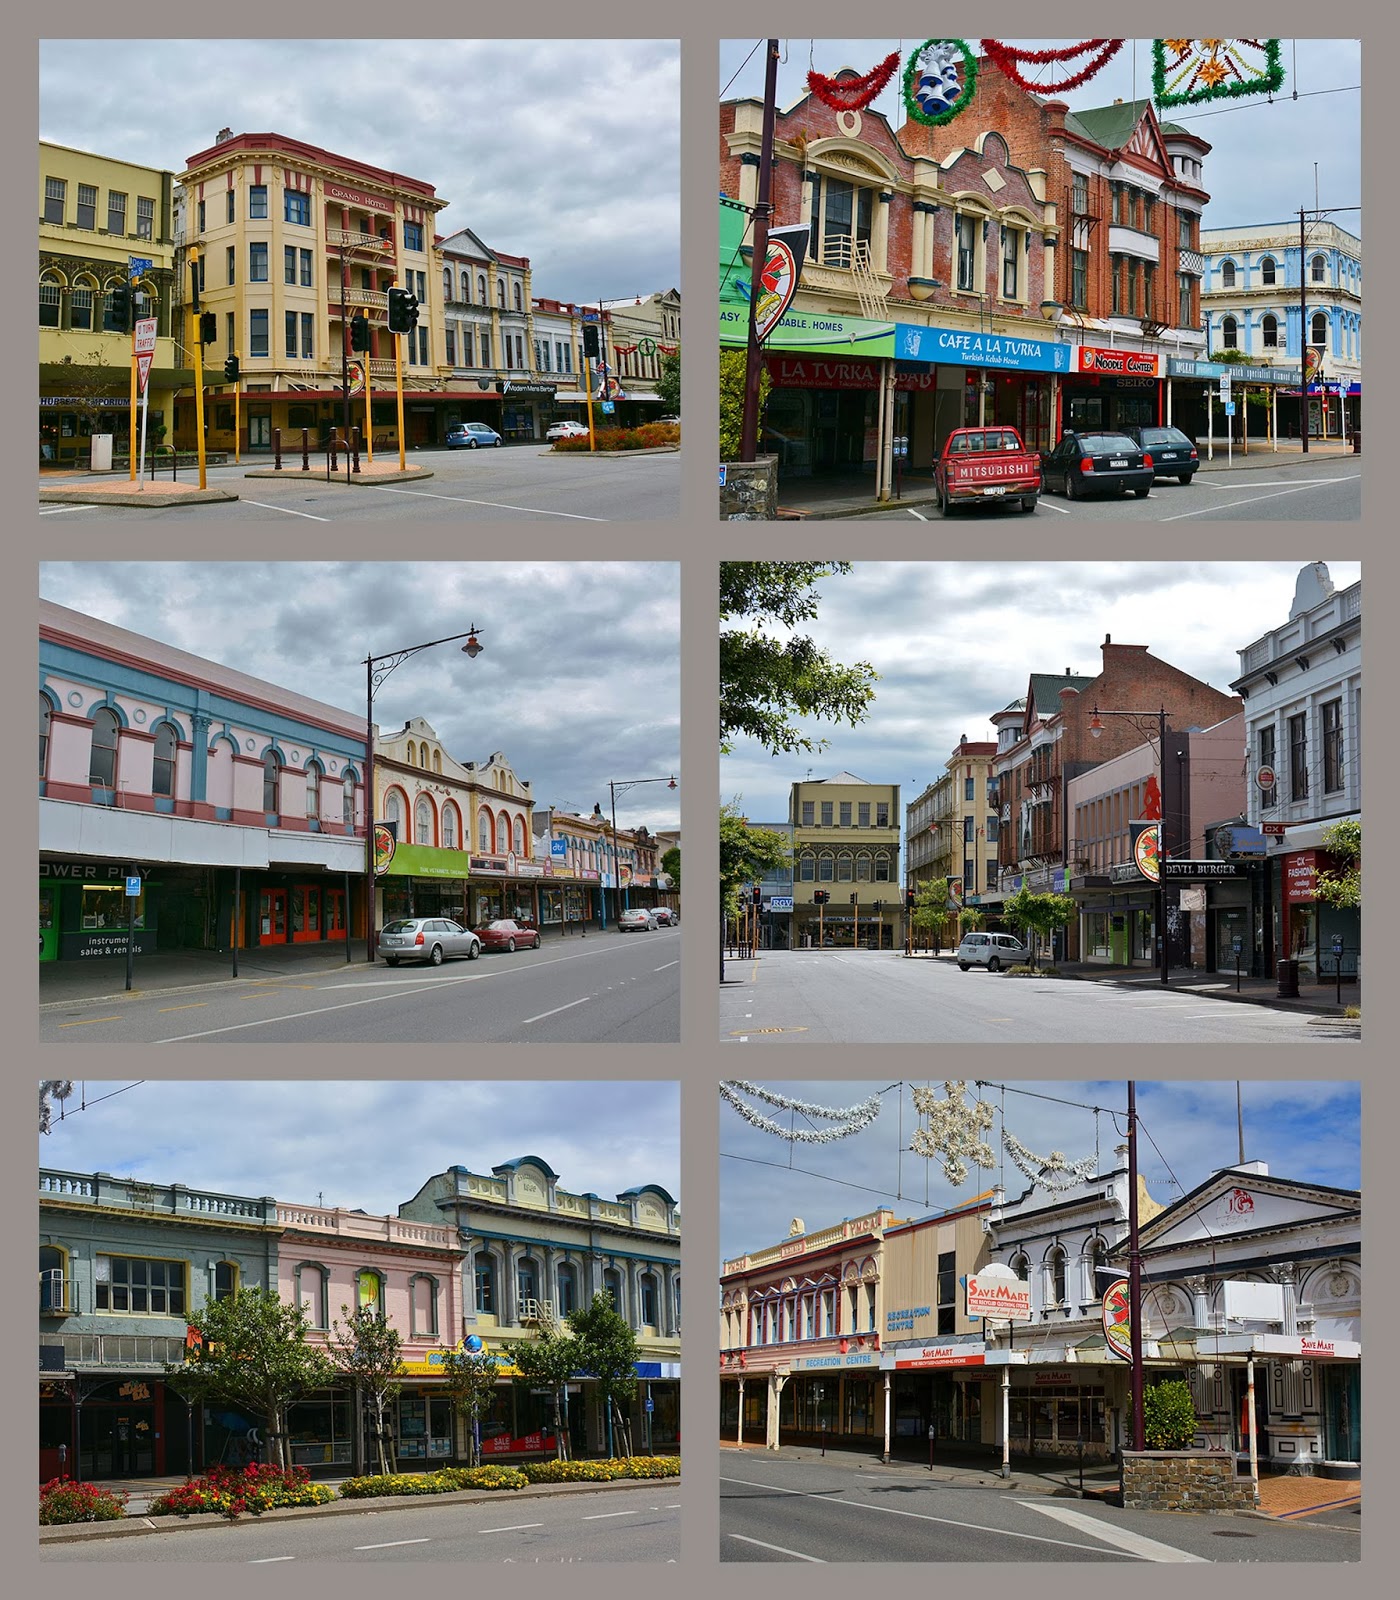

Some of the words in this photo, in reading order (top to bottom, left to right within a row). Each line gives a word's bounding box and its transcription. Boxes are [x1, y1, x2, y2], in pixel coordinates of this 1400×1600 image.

[331, 188, 360, 202] GRAND
[365, 197, 388, 210] HOTEL
[719, 311, 740, 321] ASY
[813, 321, 843, 332] HOMES
[143, 323, 154, 334] TURN
[137, 337, 154, 348] TRAFFIC
[939, 333, 971, 350] CAFE
[973, 338, 983, 351] A
[986, 338, 1001, 353] LA
[1004, 341, 1042, 357] TURKA
[961, 352, 984, 362] Turkish
[985, 354, 1002, 364] Kebab
[1003, 356, 1019, 365] House
[1094, 353, 1123, 372] NOODLE
[1126, 357, 1154, 373] CANTEEN
[781, 360, 806, 378] LA
[811, 362, 873, 381] TURKA
[1246, 369, 1271, 379] specialist
[1273, 370, 1291, 381] diamond
[1117, 379, 1154, 388] SEIKO
[86, 397, 131, 406] MPORIUM
[960, 463, 1029, 478] MITSUBISHI
[1264, 825, 1279, 833] CX
[552, 842, 564, 852] dtr
[1296, 856, 1306, 866] CX
[39, 864, 97, 878] OWER
[1166, 864, 1194, 874] DEVIL
[1197, 864, 1236, 874] BURGER
[130, 878, 137, 886] P
[80, 947, 103, 956] sales
[105, 946, 111, 954] &
[113, 945, 142, 954] renals
[850, 1217, 877, 1236] YMCA
[887, 1306, 931, 1321] RECREATION
[887, 1319, 914, 1332] CENTRE
[806, 1357, 841, 1368] RECREATION
[846, 1355, 872, 1365] CENTRE
[494, 1437, 510, 1446] SALE
[525, 1436, 540, 1444] SALE
